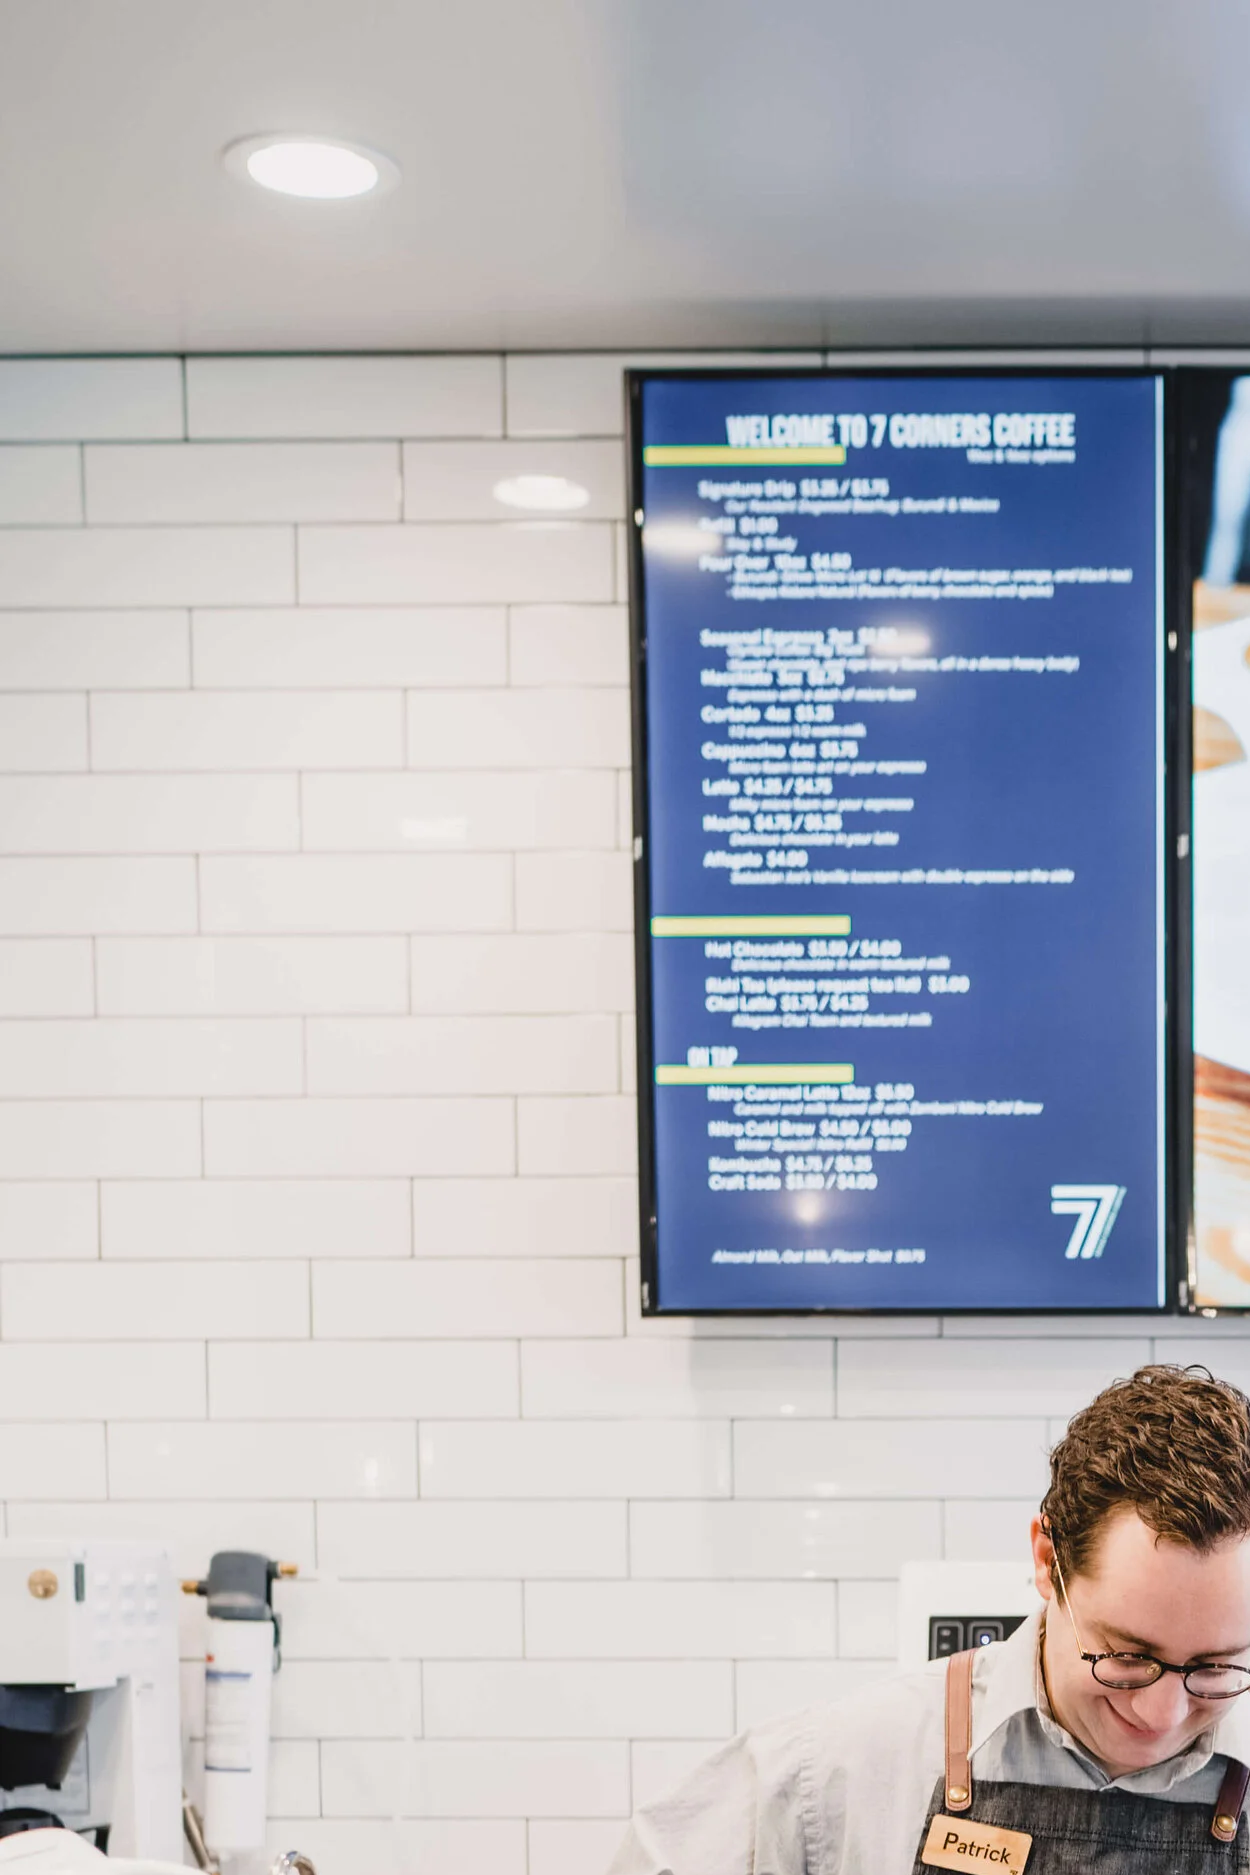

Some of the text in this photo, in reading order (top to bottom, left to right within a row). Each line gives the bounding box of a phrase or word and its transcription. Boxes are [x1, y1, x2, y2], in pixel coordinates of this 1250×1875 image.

[727, 414, 1075, 446] WELCOME TO 7 CORNERS COFFEE
[702, 779, 739, 795] Latte
[733, 942, 804, 957] Chocolate
[740, 994, 776, 1011] Latte
[804, 1084, 839, 1102] Latte
[1051, 1184, 1127, 1260] 7
[942, 1831, 1012, 1866] Patrick
